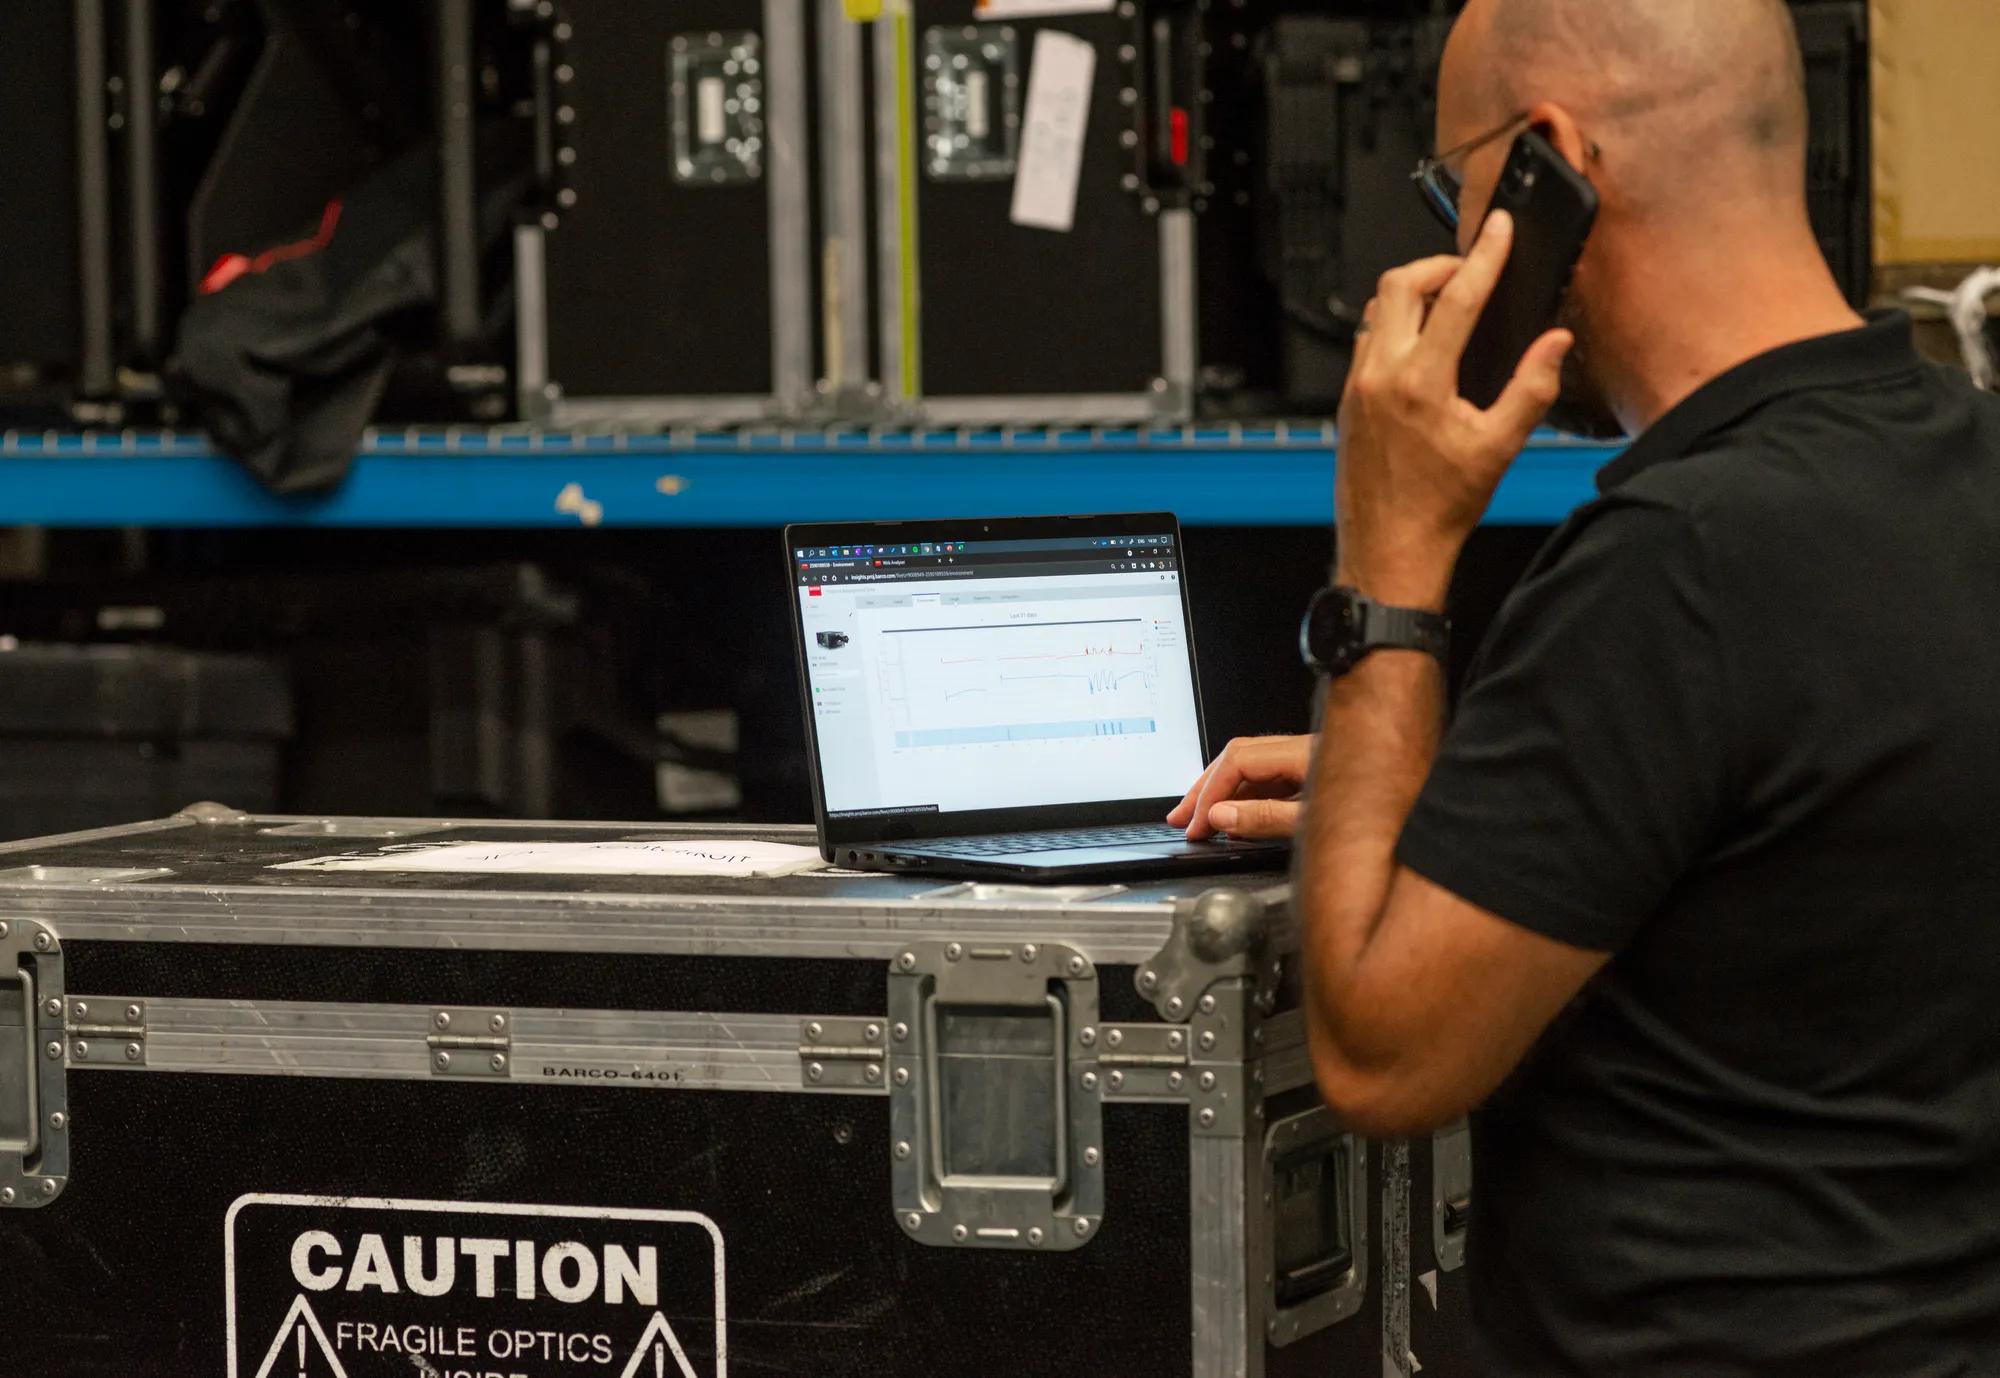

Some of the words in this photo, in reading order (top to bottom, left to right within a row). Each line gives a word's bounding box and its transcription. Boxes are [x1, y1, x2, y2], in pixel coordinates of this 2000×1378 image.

[290, 1230, 658, 1306] CAUTION
[336, 1322, 476, 1357] FRAGILE
[488, 1329, 613, 1364] OPTICS
